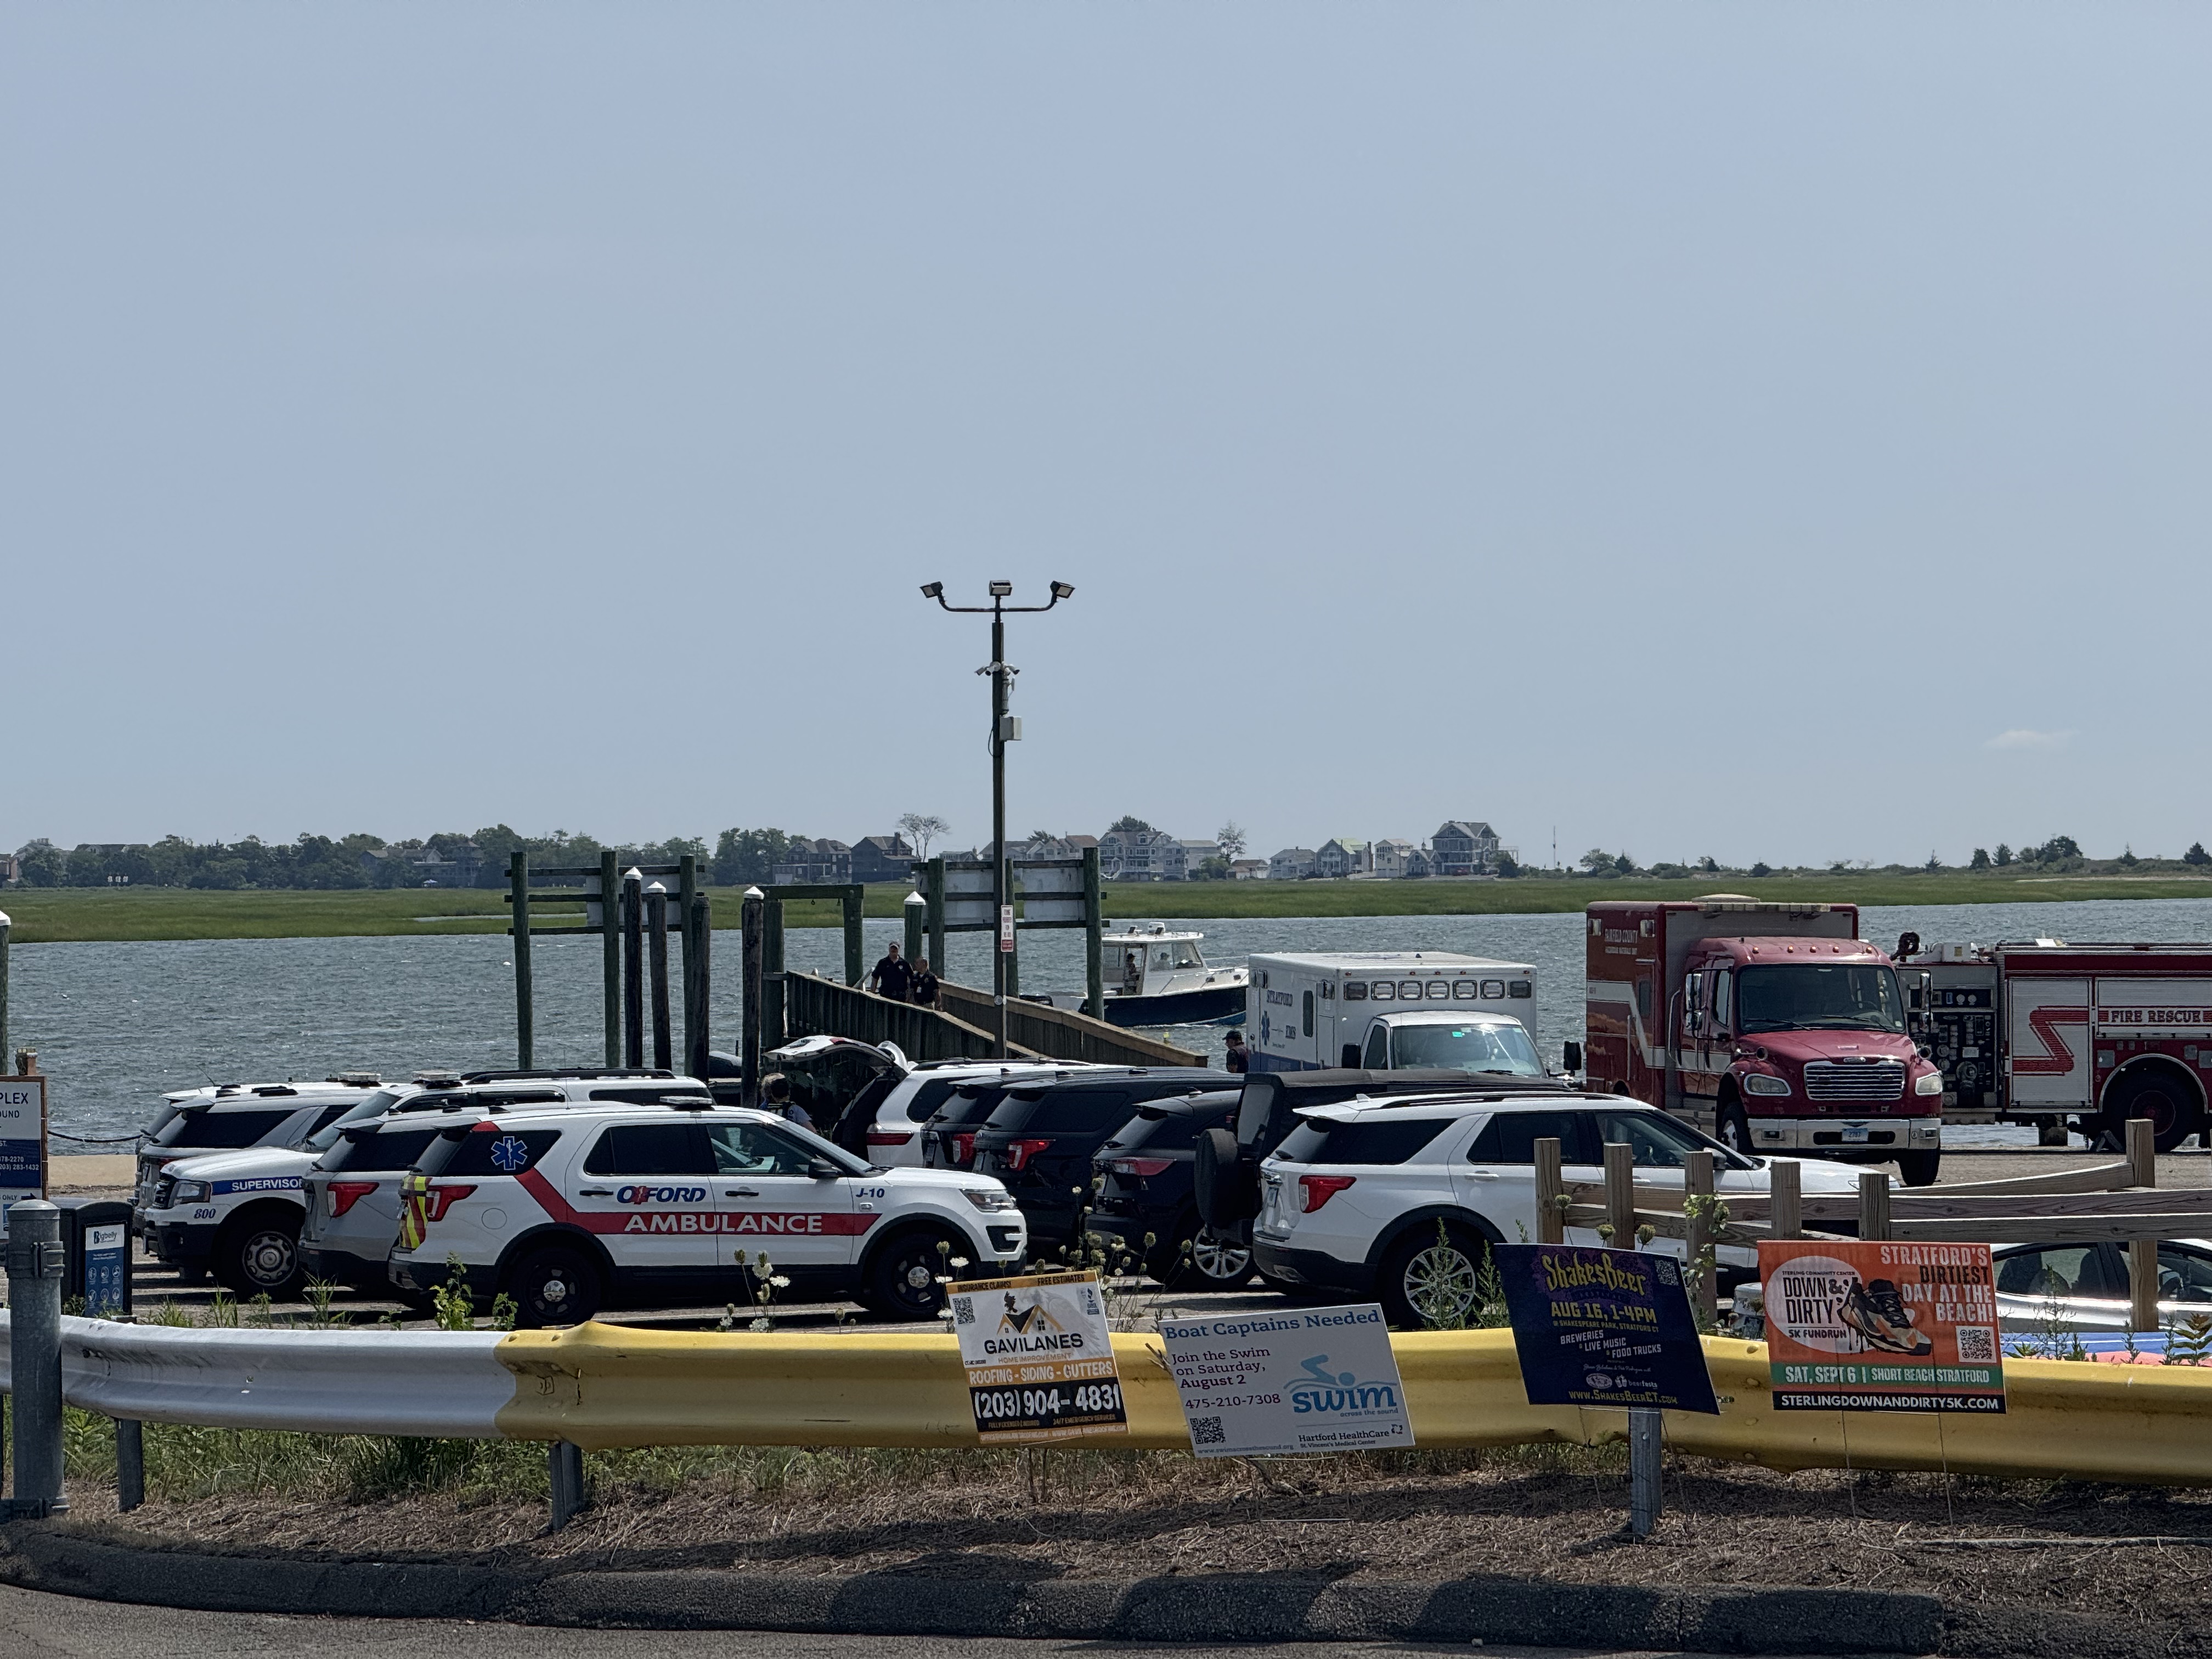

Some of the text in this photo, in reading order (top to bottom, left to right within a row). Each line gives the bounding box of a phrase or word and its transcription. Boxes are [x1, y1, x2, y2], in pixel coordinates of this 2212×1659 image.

[2111, 1011, 2201, 1023] FIRE RESCUE
[856, 1187, 885, 1198] J-10
[194, 1208, 217, 1220] 800
[624, 1213, 823, 1233] AMBULANCE
[1881, 1246, 1988, 1266] STRATFORD'S
[1037, 1274, 1085, 1286] FREE ESTIMATES
[1541, 1251, 1646, 1297] ShakesBeer
[1920, 1265, 1989, 1284] DIRTIEST
[1783, 1277, 1844, 1297] DOWN &
[1902, 1283, 1991, 1304] DAY AT THE
[1551, 1302, 1657, 1323] AUG 16, 1-4PM
[1786, 1299, 1833, 1324] DIRTY
[1936, 1302, 1994, 1322] BEACH!
[1164, 1310, 1380, 1339] Boat Captains Needed
[1601, 1321, 1619, 1329] PARK,
[1620, 1323, 1651, 1331] STRATFORD
[1788, 1329, 1847, 1339] 5K FUNDRUN
[984, 1333, 1084, 1355] GAVILANES
[1560, 1329, 1604, 1345] BREWERIES
[1584, 1342, 1601, 1352] LIVE
[1603, 1337, 1627, 1349] MUSIC
[1019, 1353, 1071, 1363] IMPROVEMENT
[1172, 1346, 1271, 1365] Join the Swim
[1612, 1347, 1632, 1358] FOOD
[1633, 1344, 1662, 1356] TRUCKS
[969, 1368, 1013, 1385] ROOFING
[1020, 1365, 1054, 1382] SIDING
[1063, 1361, 1113, 1379] GUTTERS
[1176, 1361, 1266, 1376] on Saturday,
[1785, 1366, 1813, 1385] SAT,
[1815, 1367, 1846, 1383] SEPT
[1847, 1367, 1857, 1383] 6
[1871, 1368, 1903, 1381] SHORT
[1904, 1368, 1935, 1383] BEACH
[1936, 1369, 1990, 1384] STRATFORD
[1180, 1374, 1246, 1390] August 2
[1075, 1384, 1121, 1412] 4831
[1185, 1393, 1281, 1409] 475-210-7308
[1292, 1385, 1397, 1413] swim
[1781, 1395, 1999, 1410] STERLINGDOWNANDDIRTY5K.COM
[1298, 1430, 1390, 1442] Hartford HealthCare
